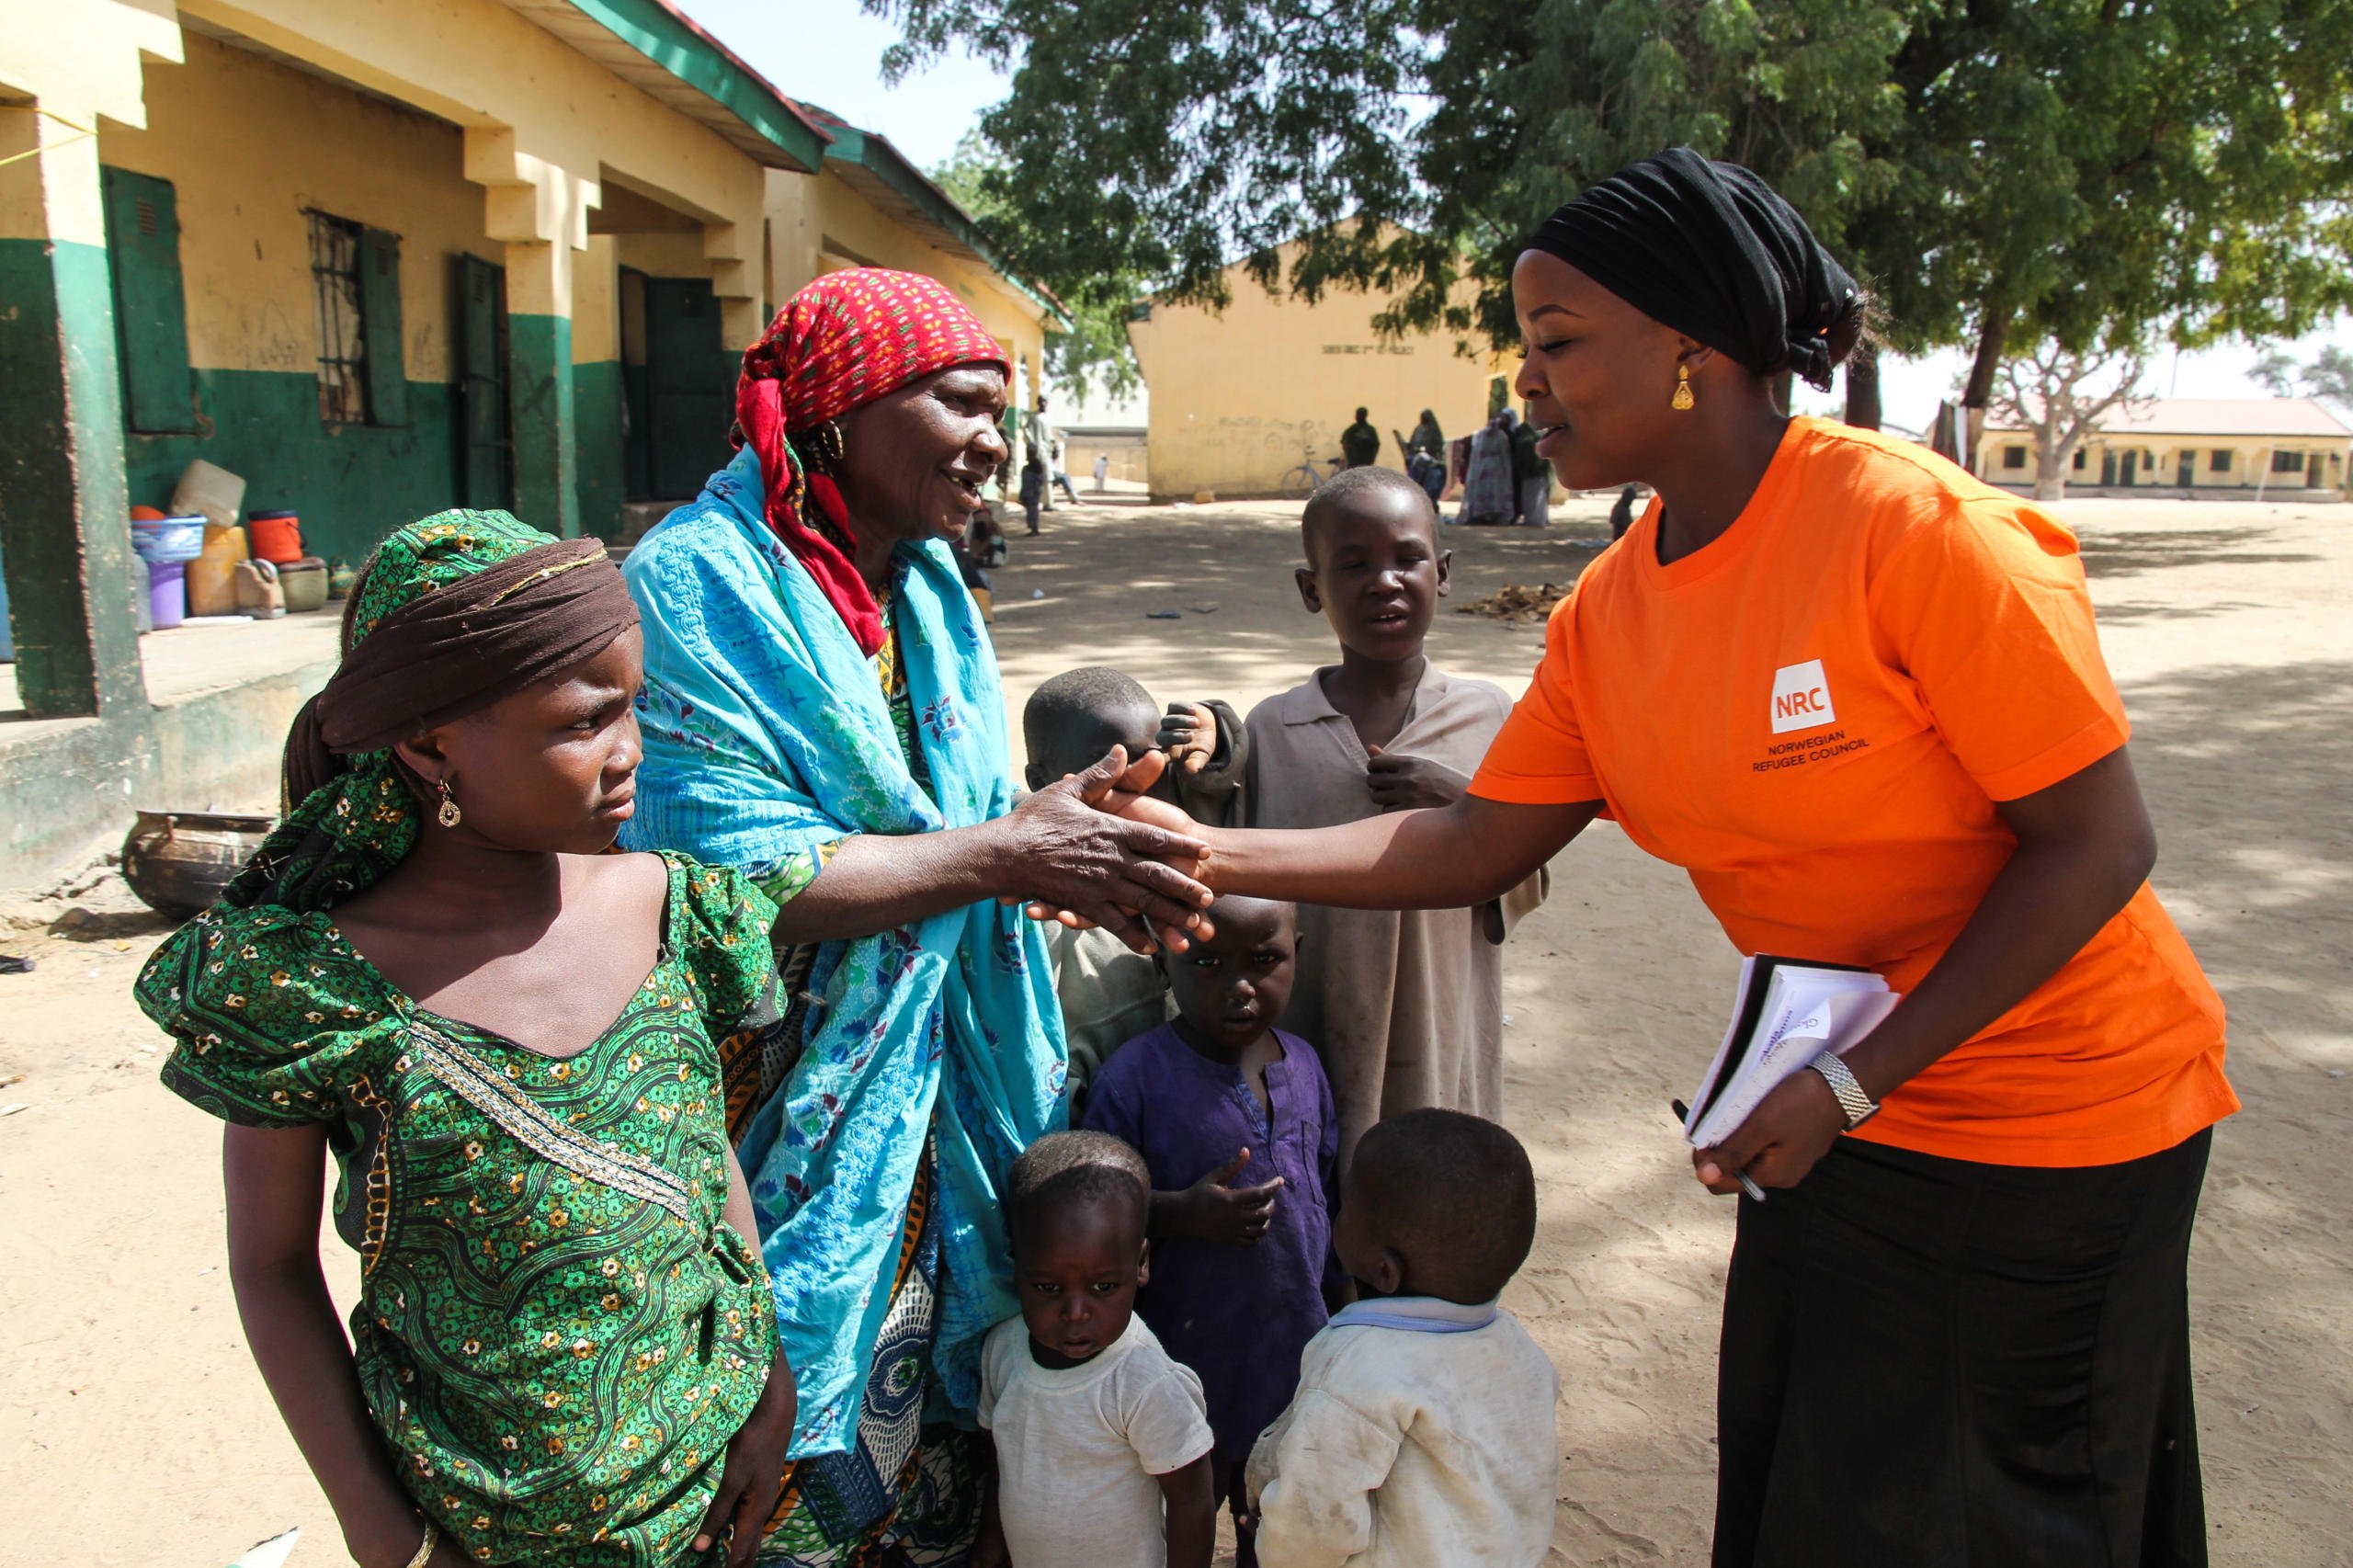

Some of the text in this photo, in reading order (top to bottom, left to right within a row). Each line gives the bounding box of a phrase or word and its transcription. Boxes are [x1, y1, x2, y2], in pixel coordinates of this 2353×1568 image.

[1776, 687, 1824, 718] NRC
[1752, 738, 1870, 772] REFUGEE COUNCIL
[1768, 730, 1846, 756] NORWEGIAN
